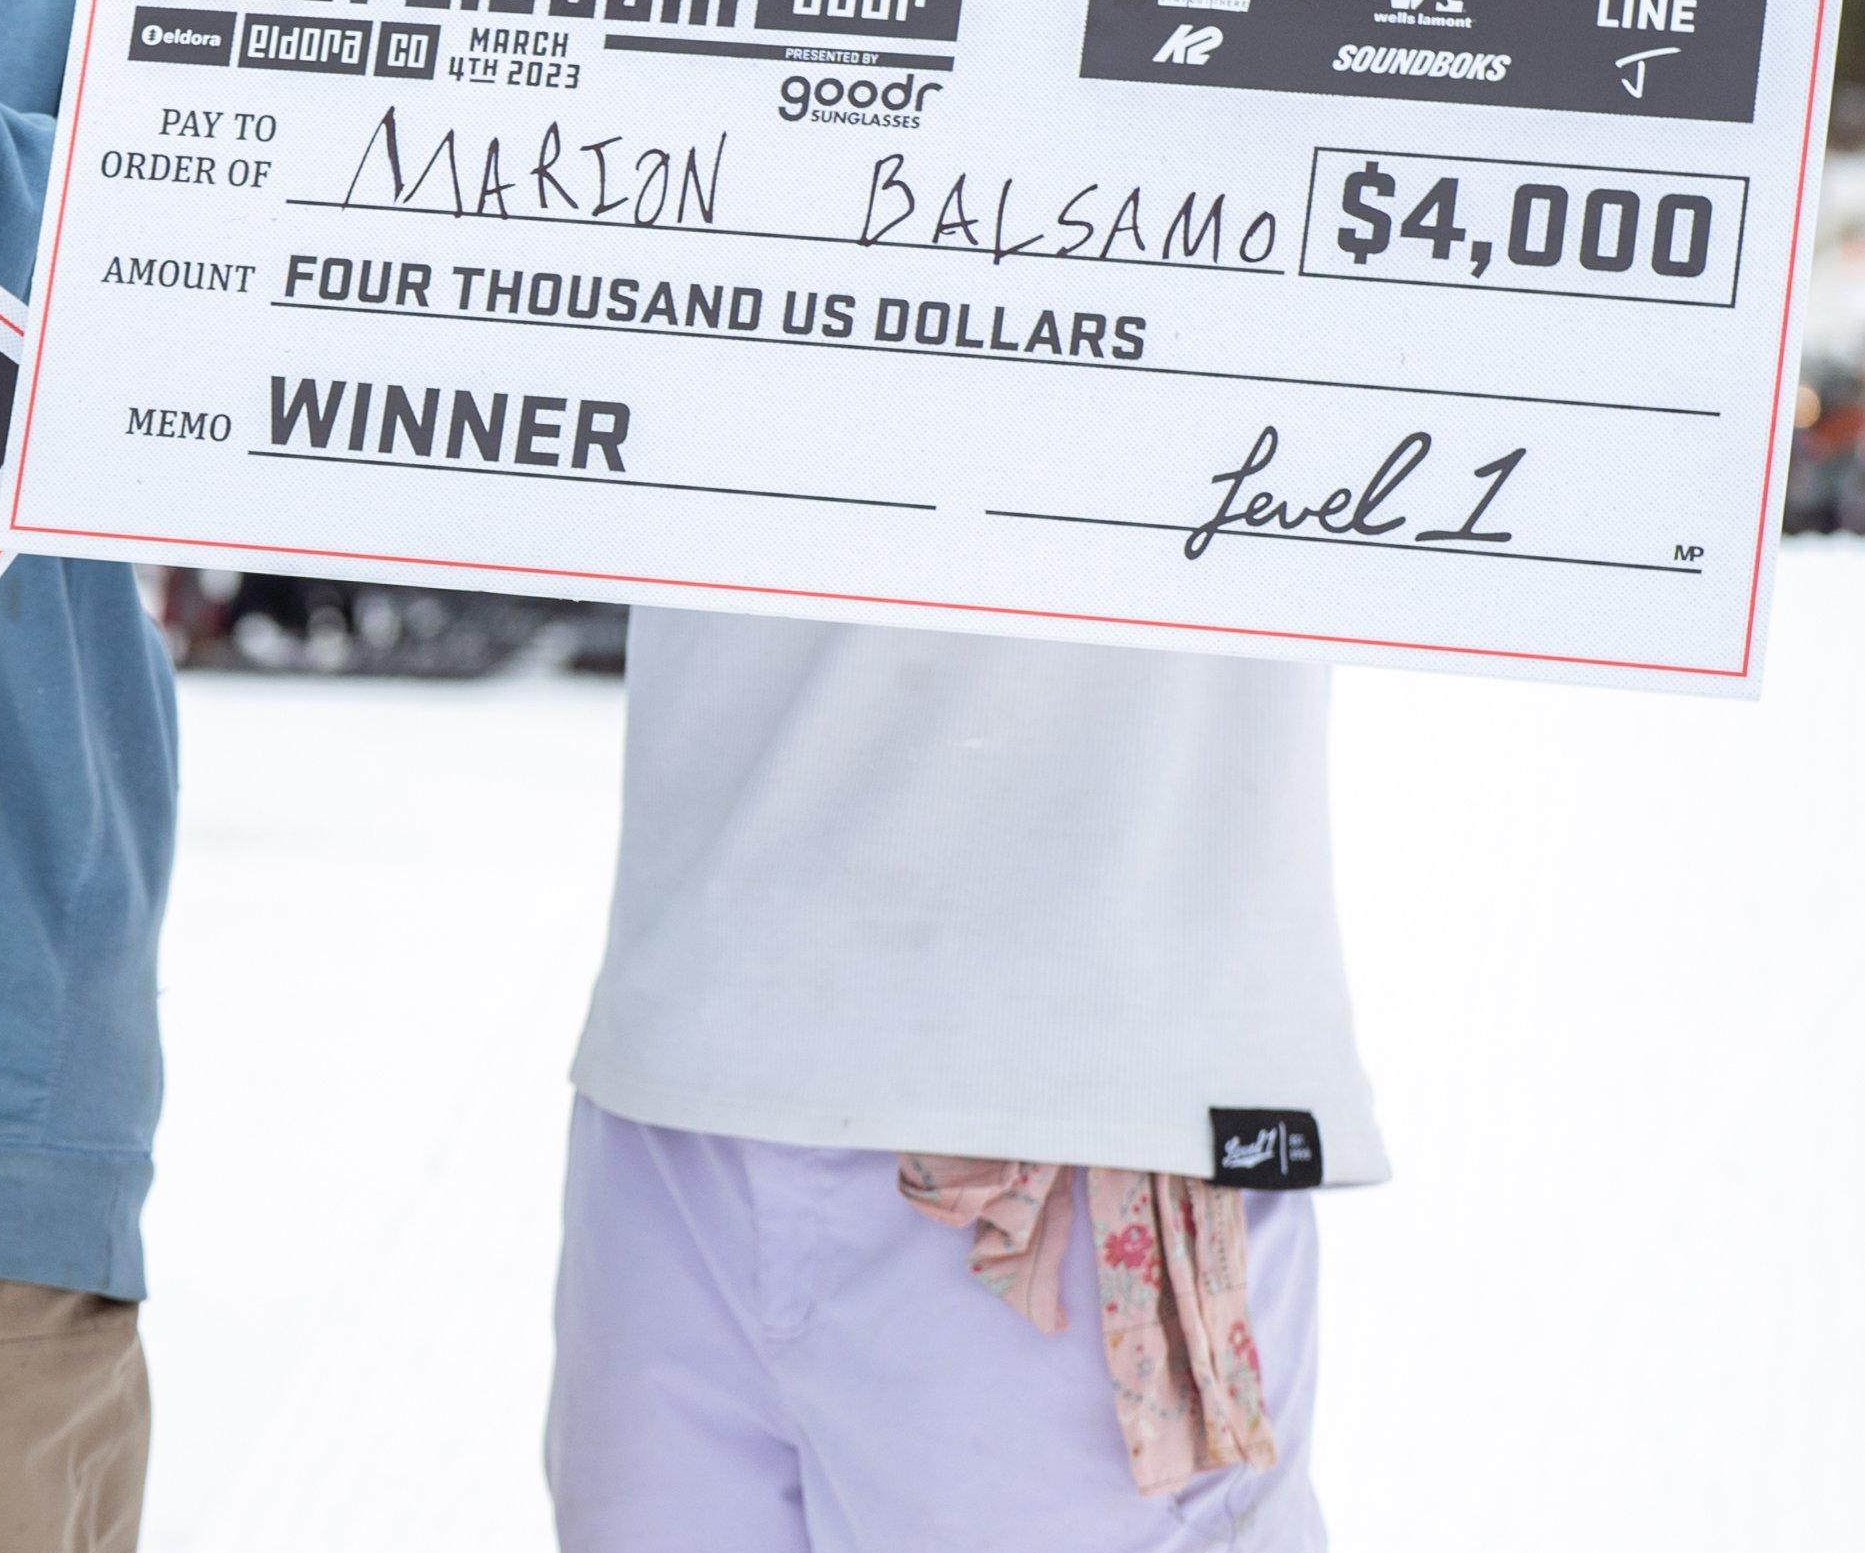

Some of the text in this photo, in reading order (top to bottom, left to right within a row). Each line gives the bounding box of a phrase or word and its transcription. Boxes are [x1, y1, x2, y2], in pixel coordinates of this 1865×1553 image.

[161, 27, 222, 48] eldora
[1374, 12, 1473, 29] wells lamont
[387, 33, 428, 68] CO
[470, 27, 568, 57] MARCH
[785, 48, 878, 64] PRESENTED BY
[1152, 24, 1223, 65] K2
[449, 57, 579, 88] 4TH 2023
[1332, 44, 1511, 81] SOUNDBOKS
[778, 73, 942, 121] goodr
[160, 109, 276, 142] PAY TO
[811, 110, 919, 128] SUNGLASSES
[101, 151, 271, 187] ORDER OF
[342, 106, 1275, 265] MARION BALSAMO
[1337, 161, 1712, 278] $4,000
[101, 256, 255, 292] AMOUNT
[285, 255, 1146, 360] FOUR THOUSAND US DOLLARS
[126, 407, 231, 441] MEMO
[271, 376, 630, 472] WINNER
[1417, 446, 1527, 543] 1
